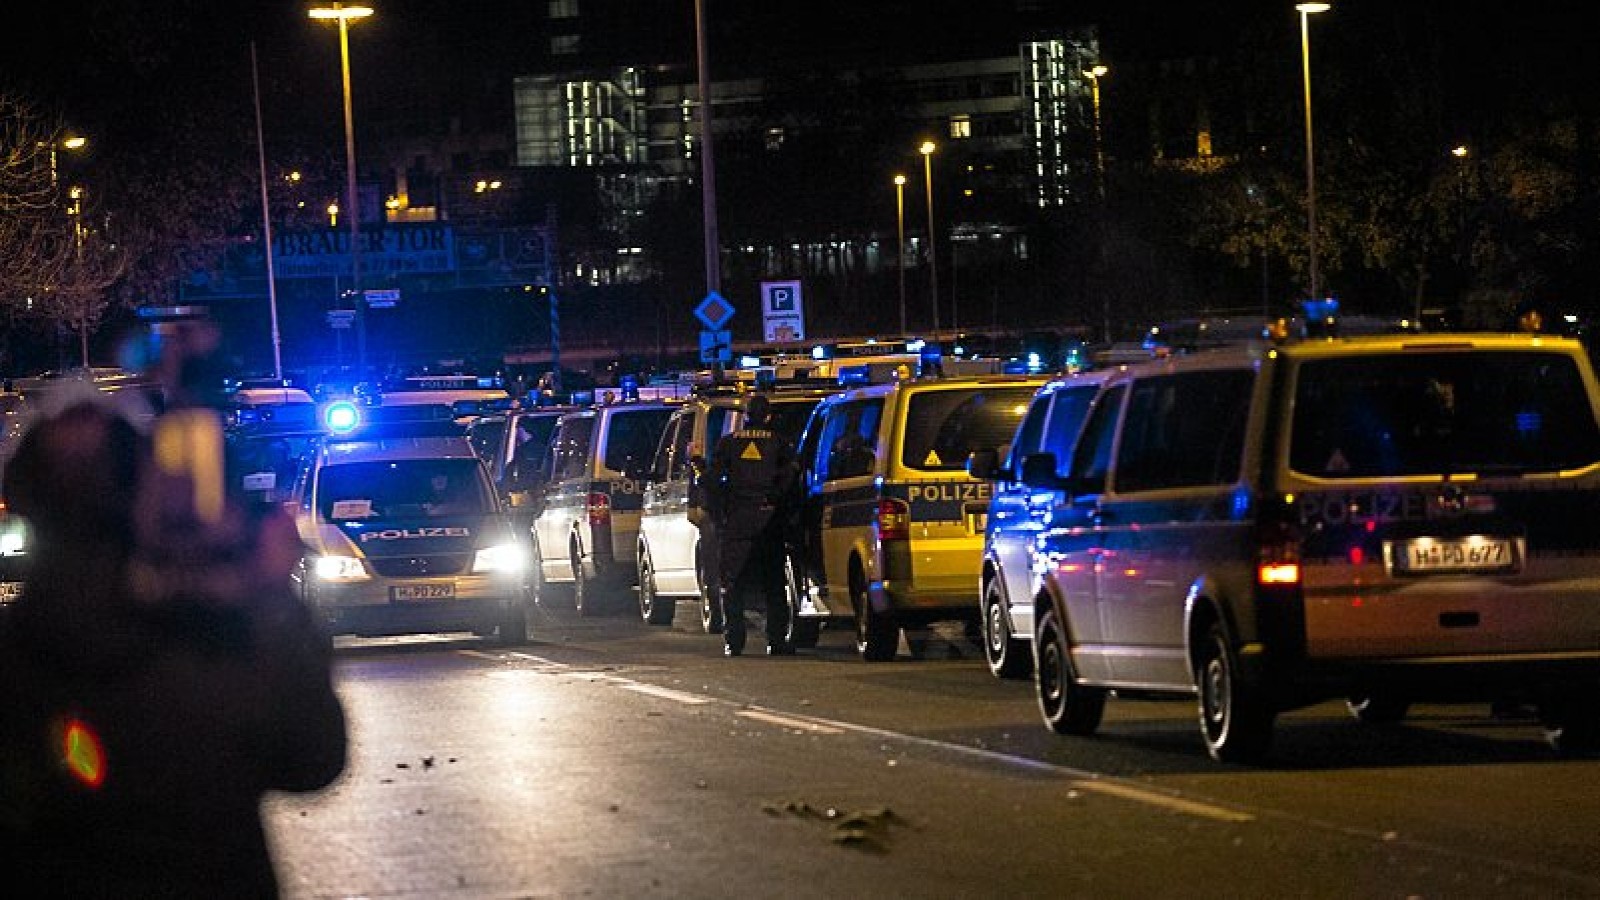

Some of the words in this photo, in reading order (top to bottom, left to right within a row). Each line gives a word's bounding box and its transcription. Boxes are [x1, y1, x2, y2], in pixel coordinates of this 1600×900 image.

[398, 225, 445, 250] TOR
[775, 289, 788, 309] P
[360, 526, 470, 542] POLIZEI
